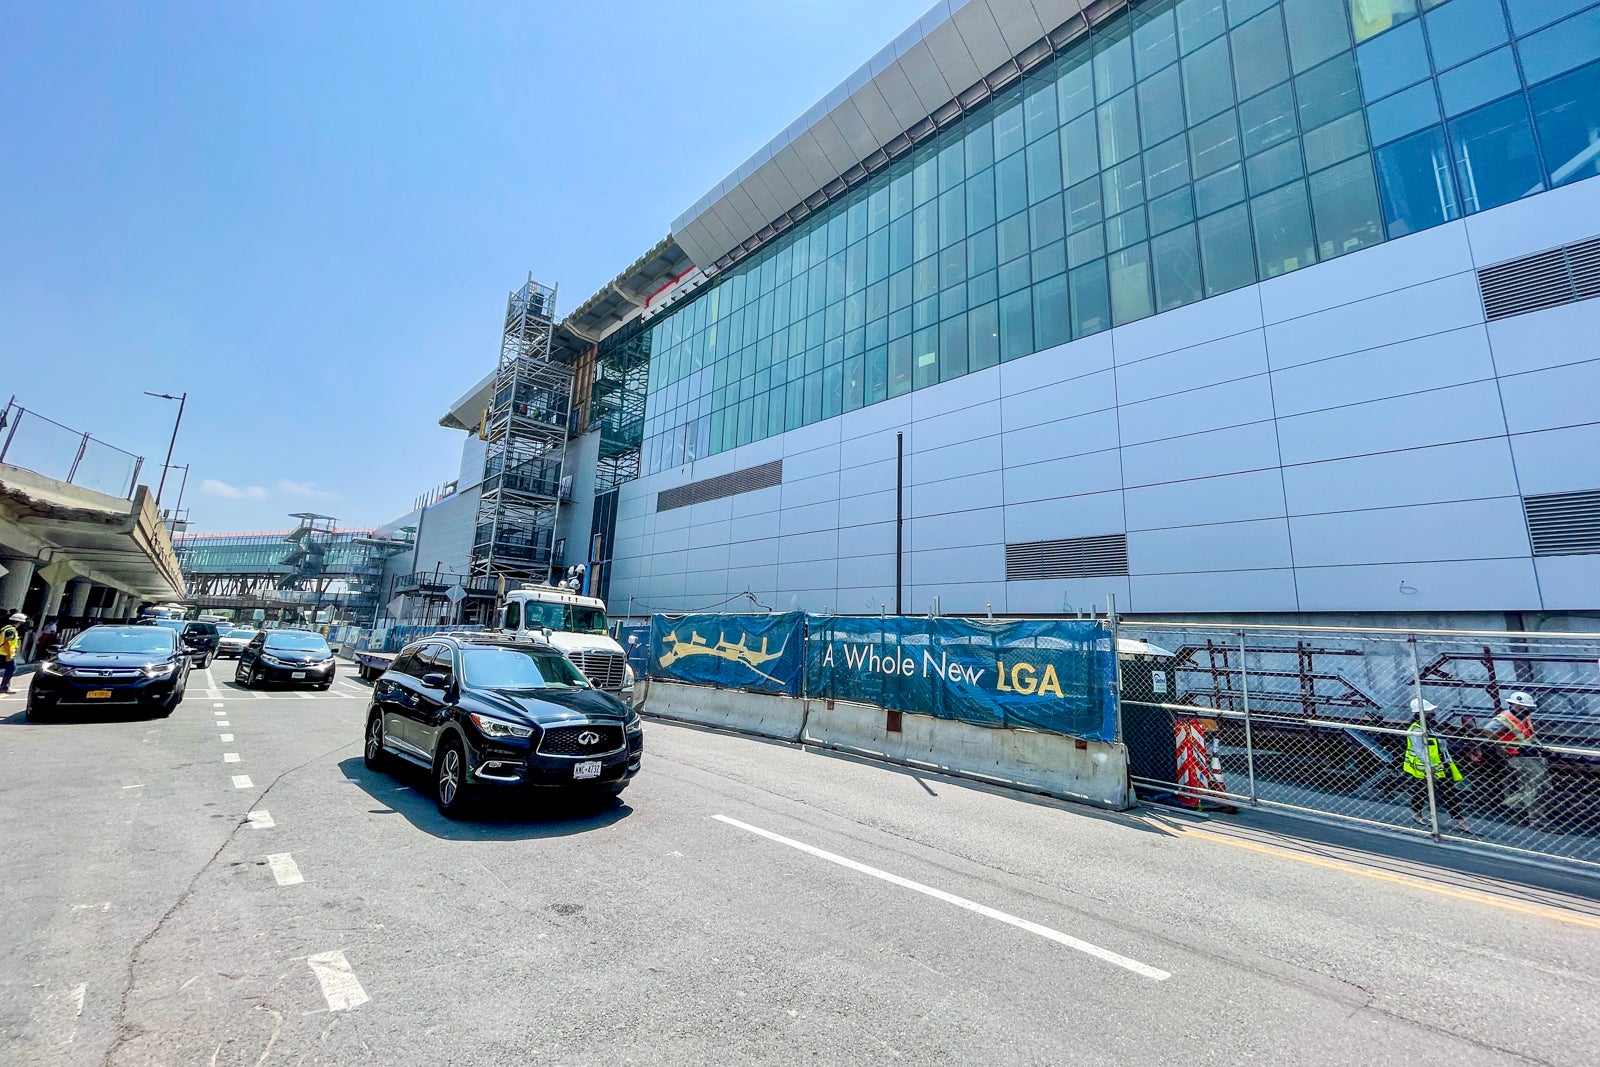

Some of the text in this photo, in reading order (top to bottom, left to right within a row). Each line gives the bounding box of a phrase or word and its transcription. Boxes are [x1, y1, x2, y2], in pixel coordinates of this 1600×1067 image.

[822, 643, 1065, 699] A Whole New LGA
